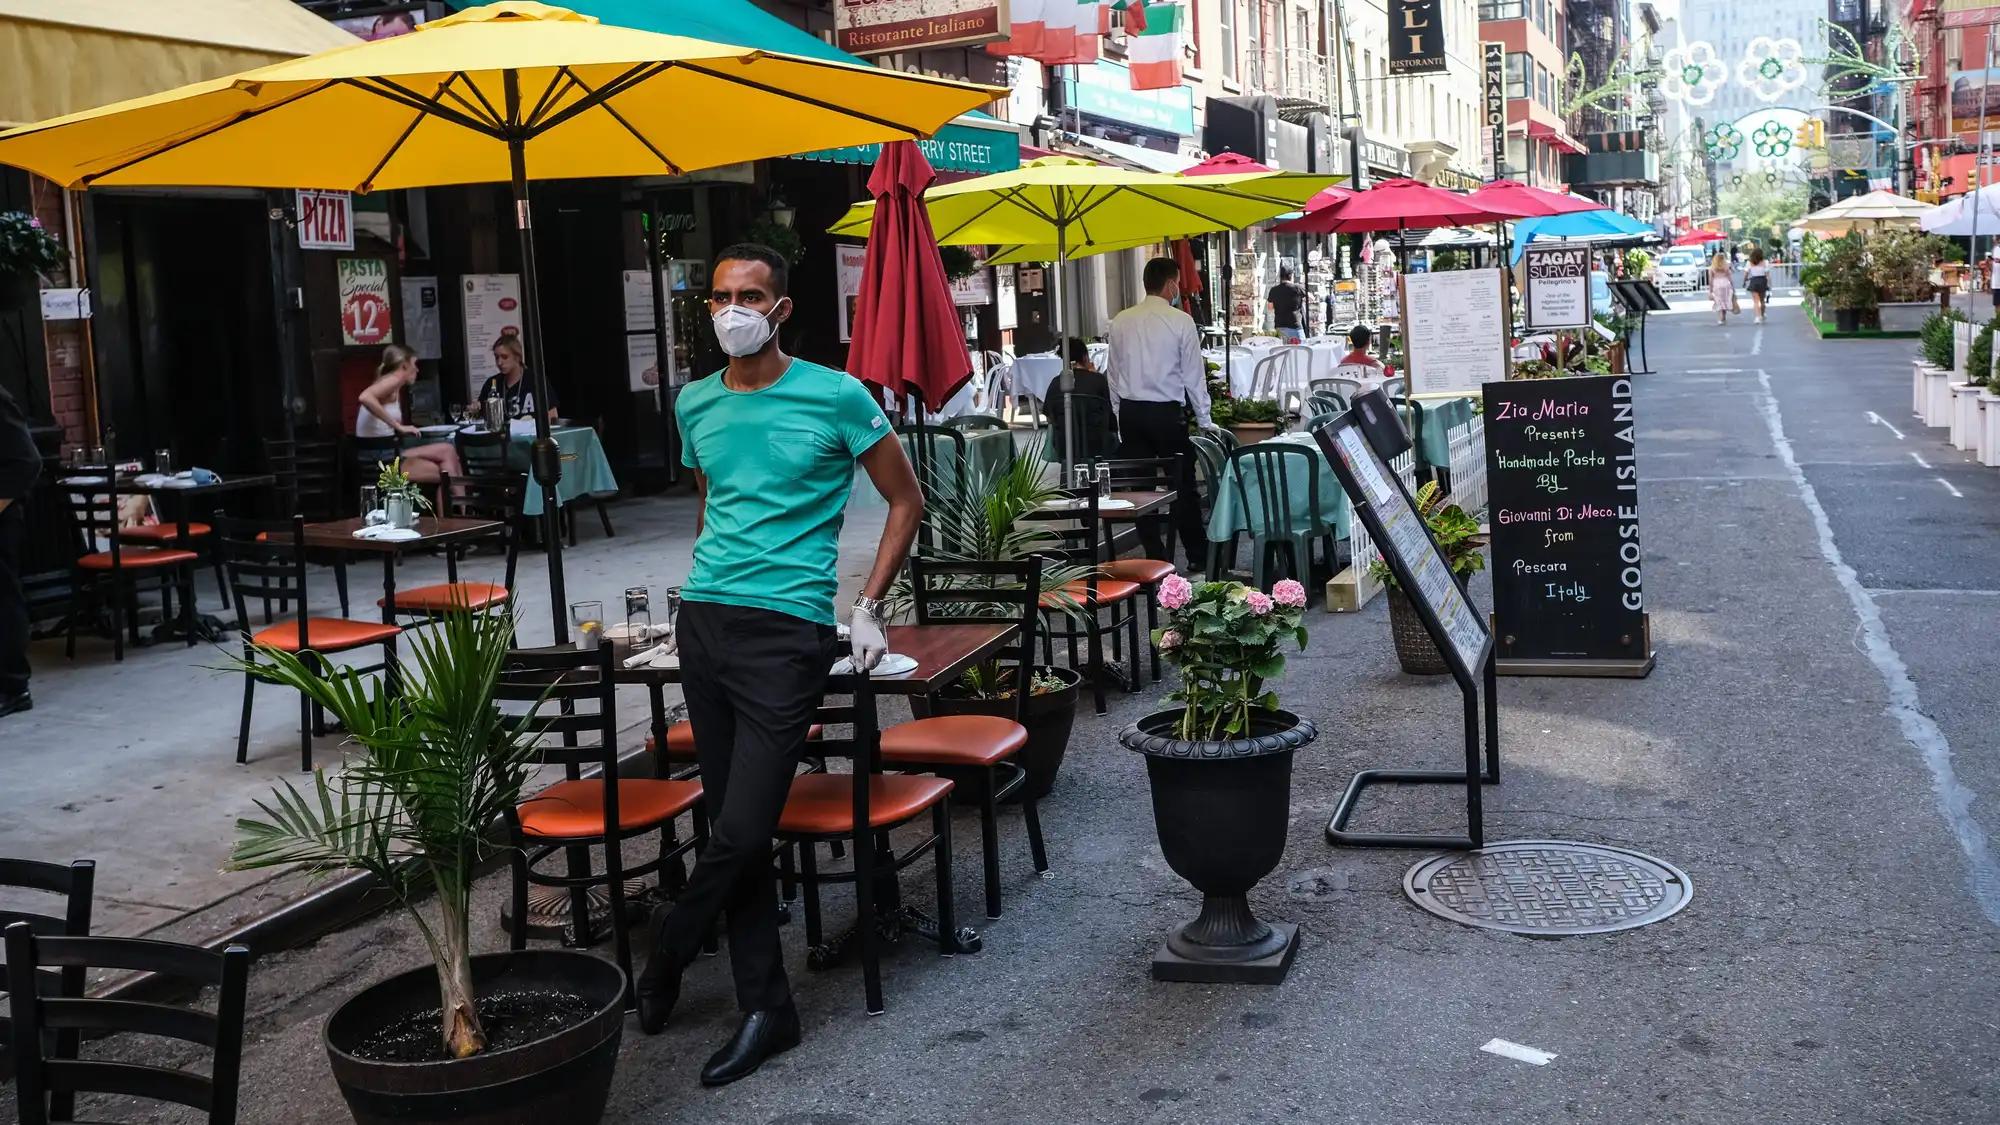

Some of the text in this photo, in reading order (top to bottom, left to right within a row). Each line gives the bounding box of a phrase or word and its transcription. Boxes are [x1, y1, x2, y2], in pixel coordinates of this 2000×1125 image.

[849, 17, 985, 46] Ristorante Italiano
[1390, 57, 1444, 68] RISTORANTE
[948, 141, 991, 164] STREET
[303, 196, 347, 243] PIZZA
[339, 259, 383, 277] PASTA
[1529, 251, 1584, 266] ZAGAT
[1530, 264, 1584, 278] SURVEY
[341, 276, 388, 300] Special
[1495, 398, 1589, 421] Zia Maria
[1524, 425, 1586, 442] Presents
[1496, 448, 1606, 470] Handmade Pasta
[1536, 474, 1568, 493] By
[1612, 379, 1643, 611] GOOSE ISLAND
[1498, 507, 1552, 524] Giovanni
[1556, 506, 1573, 521] Di
[1544, 529, 1574, 548] from
[1512, 559, 1567, 575] Pescara
[1545, 581, 1591, 602] Italy
